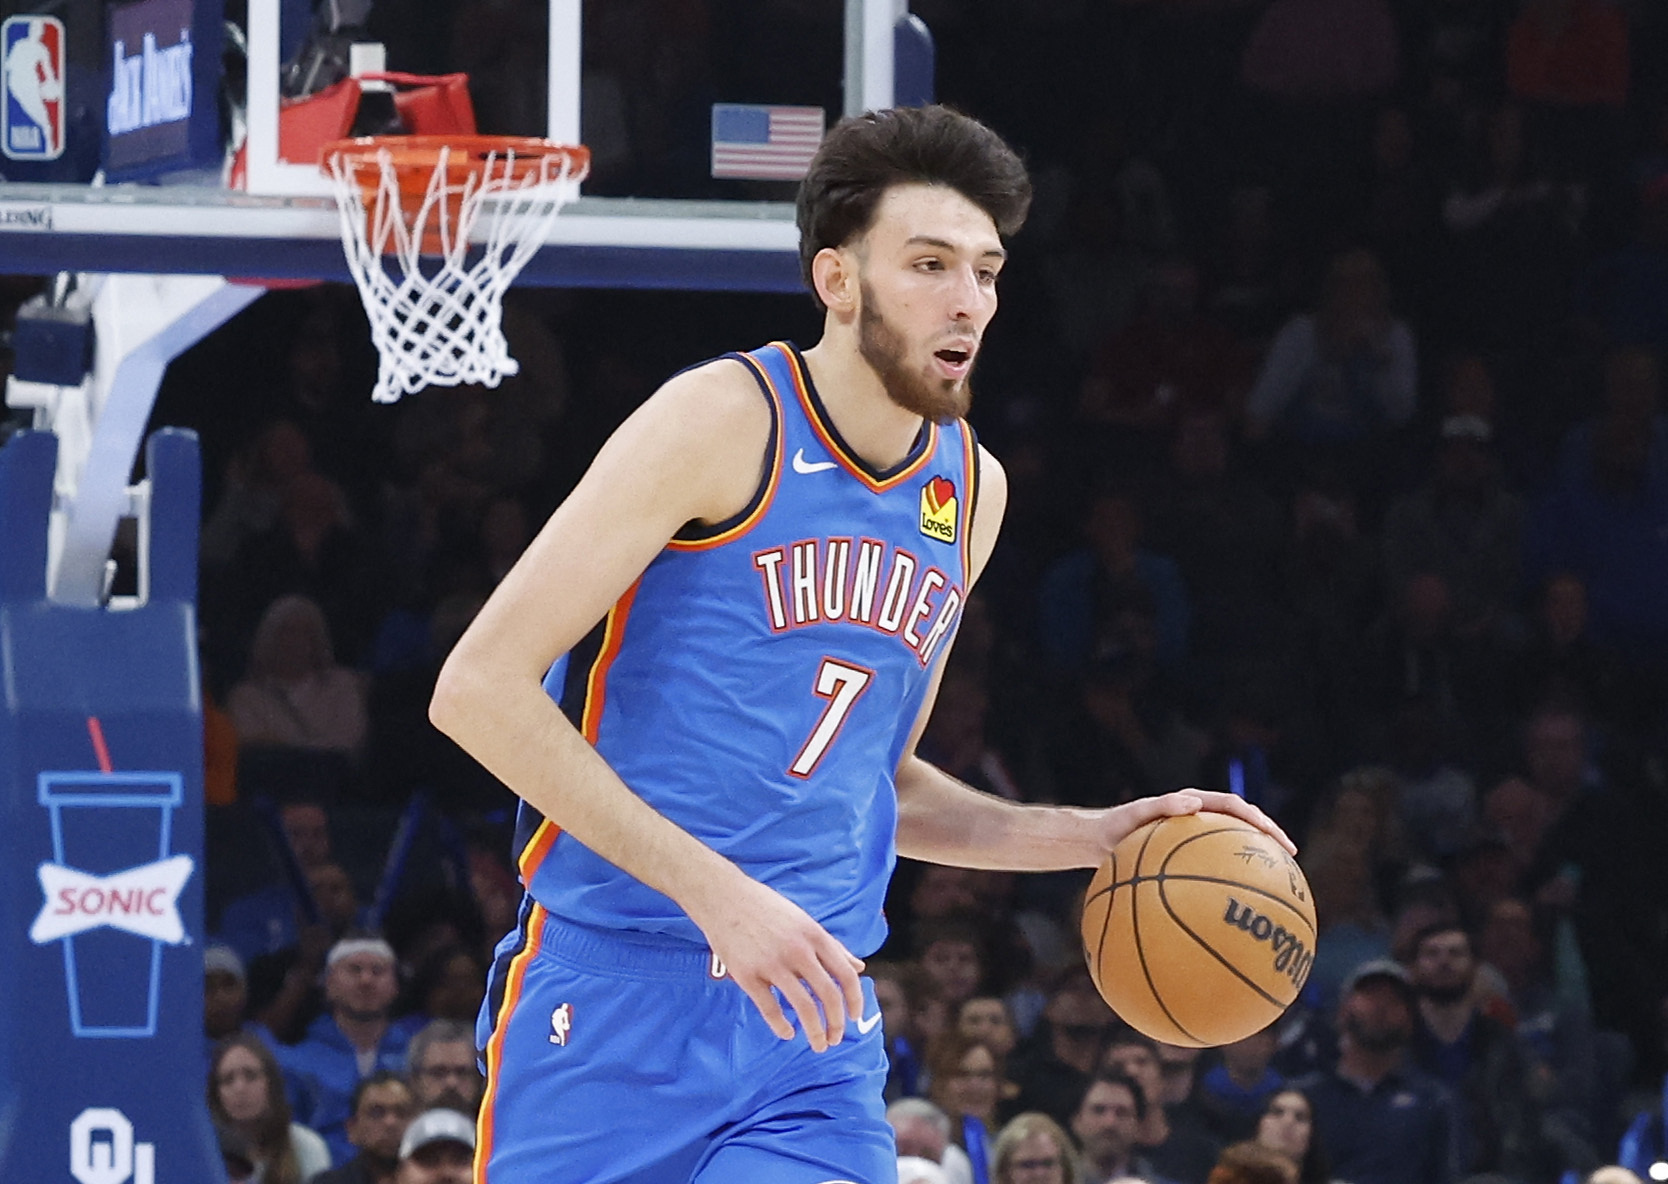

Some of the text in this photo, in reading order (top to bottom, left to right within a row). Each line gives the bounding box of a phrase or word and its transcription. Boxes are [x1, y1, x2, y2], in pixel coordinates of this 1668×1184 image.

[752, 536, 968, 670] THUNDER
[785, 655, 877, 780] 7
[54, 887, 167, 916] SONIC
